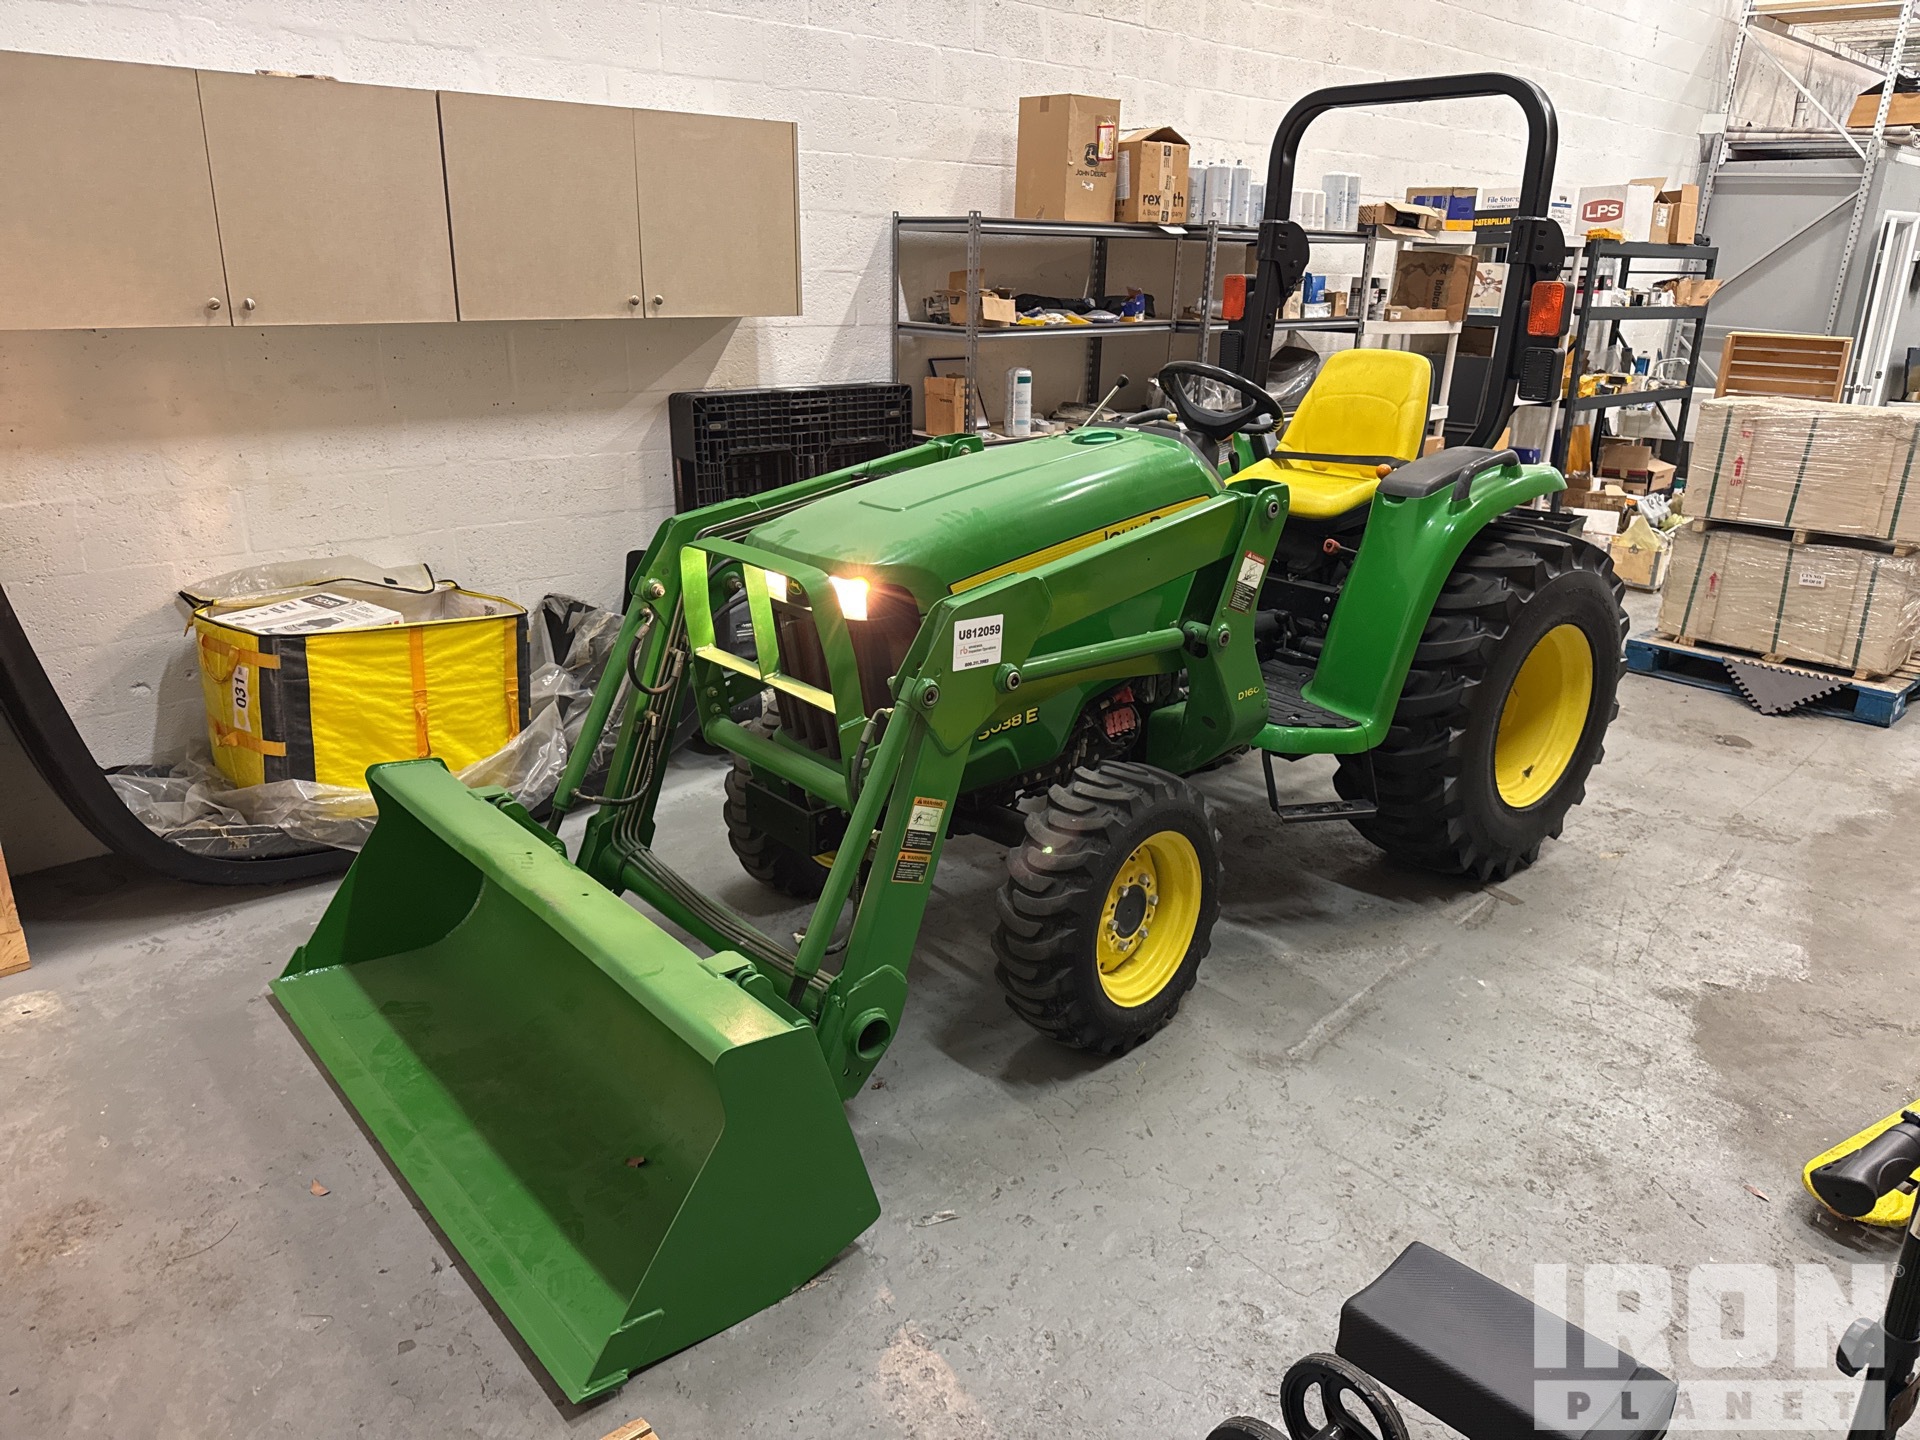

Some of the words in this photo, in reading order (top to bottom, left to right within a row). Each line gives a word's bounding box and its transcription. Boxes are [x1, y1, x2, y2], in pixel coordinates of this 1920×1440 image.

[1090, 169, 1107, 177] DEERE
[1142, 191, 1184, 208] rexth
[1487, 195, 1499, 204] File
[1499, 195, 1520, 204] Storag
[1147, 209, 1160, 217] Bosc
[1585, 203, 1620, 218] LPS
[1474, 217, 1511, 227] CATERPILLAR
[1431, 279, 1444, 309] Bobca
[958, 624, 1001, 641] U812059
[234, 677, 247, 709] 031
[1238, 686, 1260, 701] D160
[1026, 707, 1038, 724] E
